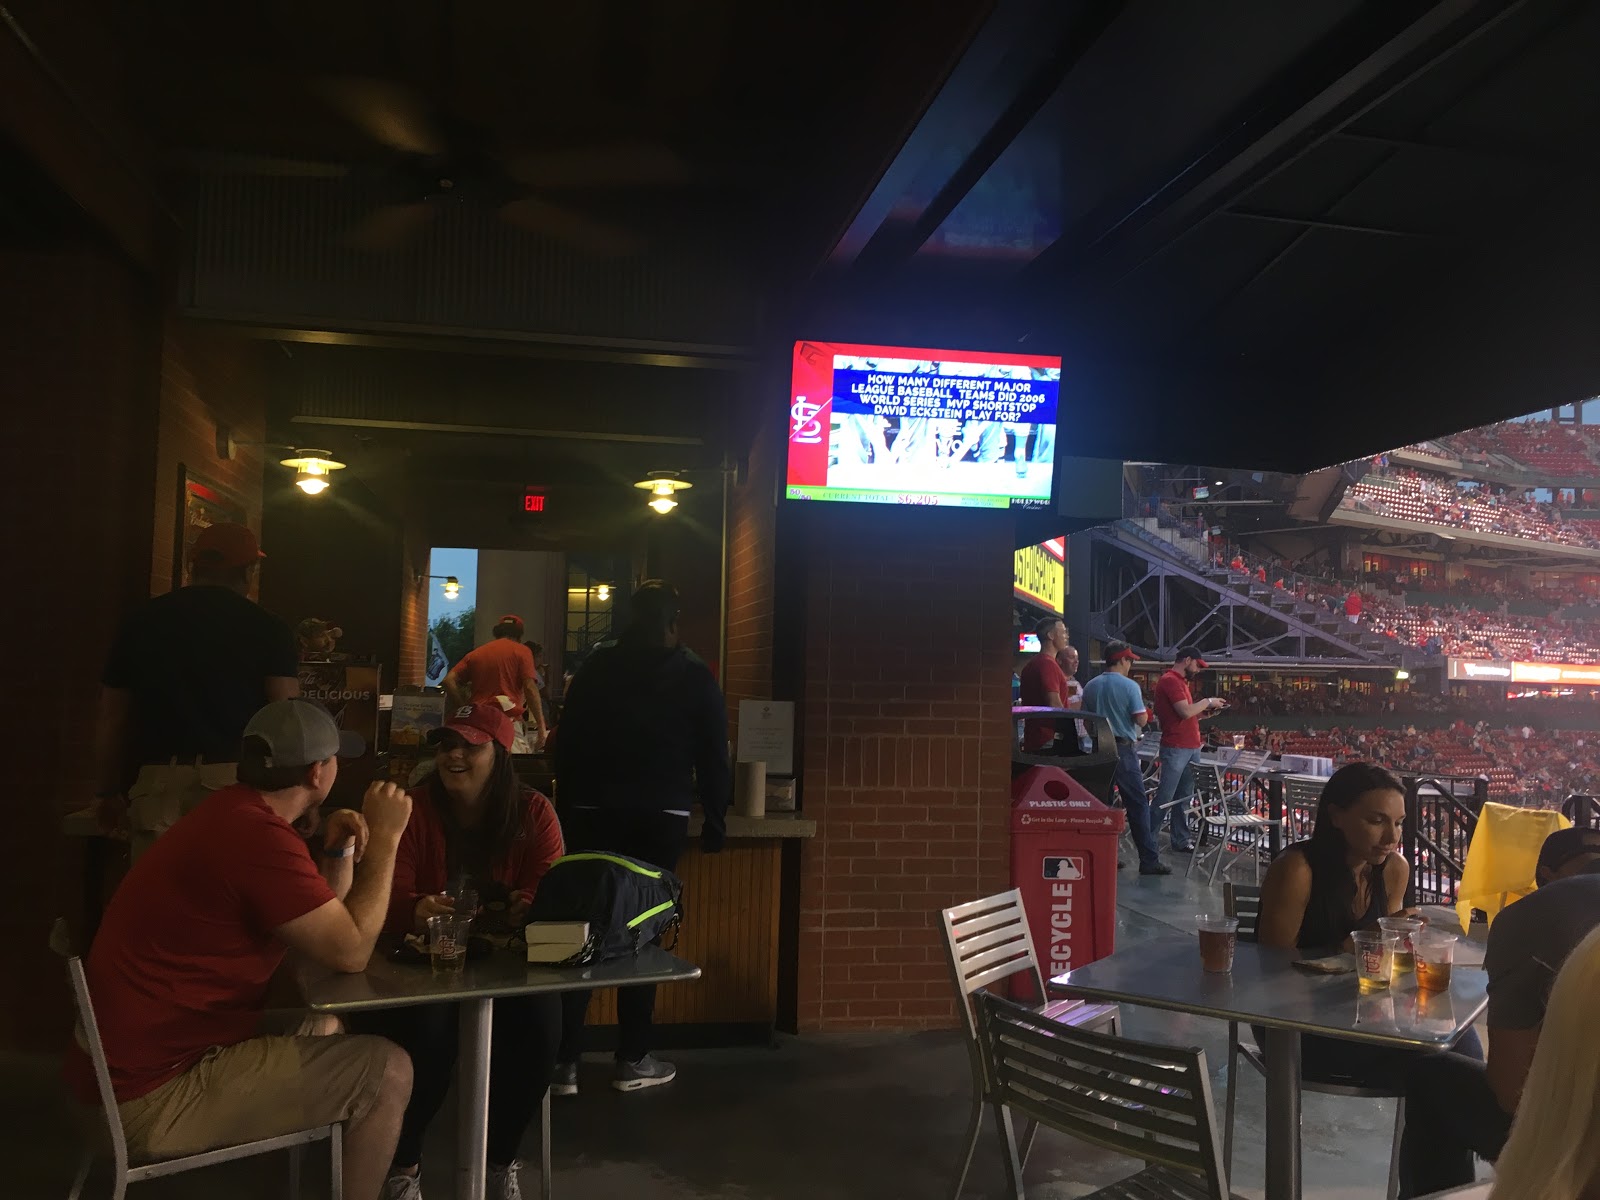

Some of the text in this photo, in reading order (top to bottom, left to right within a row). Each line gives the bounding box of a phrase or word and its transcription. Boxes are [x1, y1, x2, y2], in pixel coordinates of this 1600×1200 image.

[868, 374, 1031, 393] HOW MANY DIFFERENT MAJOR
[851, 383, 1045, 403] LEAGUE BASEBALL TEAMS DID 2006
[860, 394, 1036, 412] WORLD SERIES MVP SHORTSTOP
[874, 405, 1021, 421] DAVID ECKSTEIN PLAY FOR?
[525, 495, 545, 512] EXIT
[1029, 800, 1091, 808] PLASTIC ONLY
[1050, 883, 1073, 976] ECYCLE
